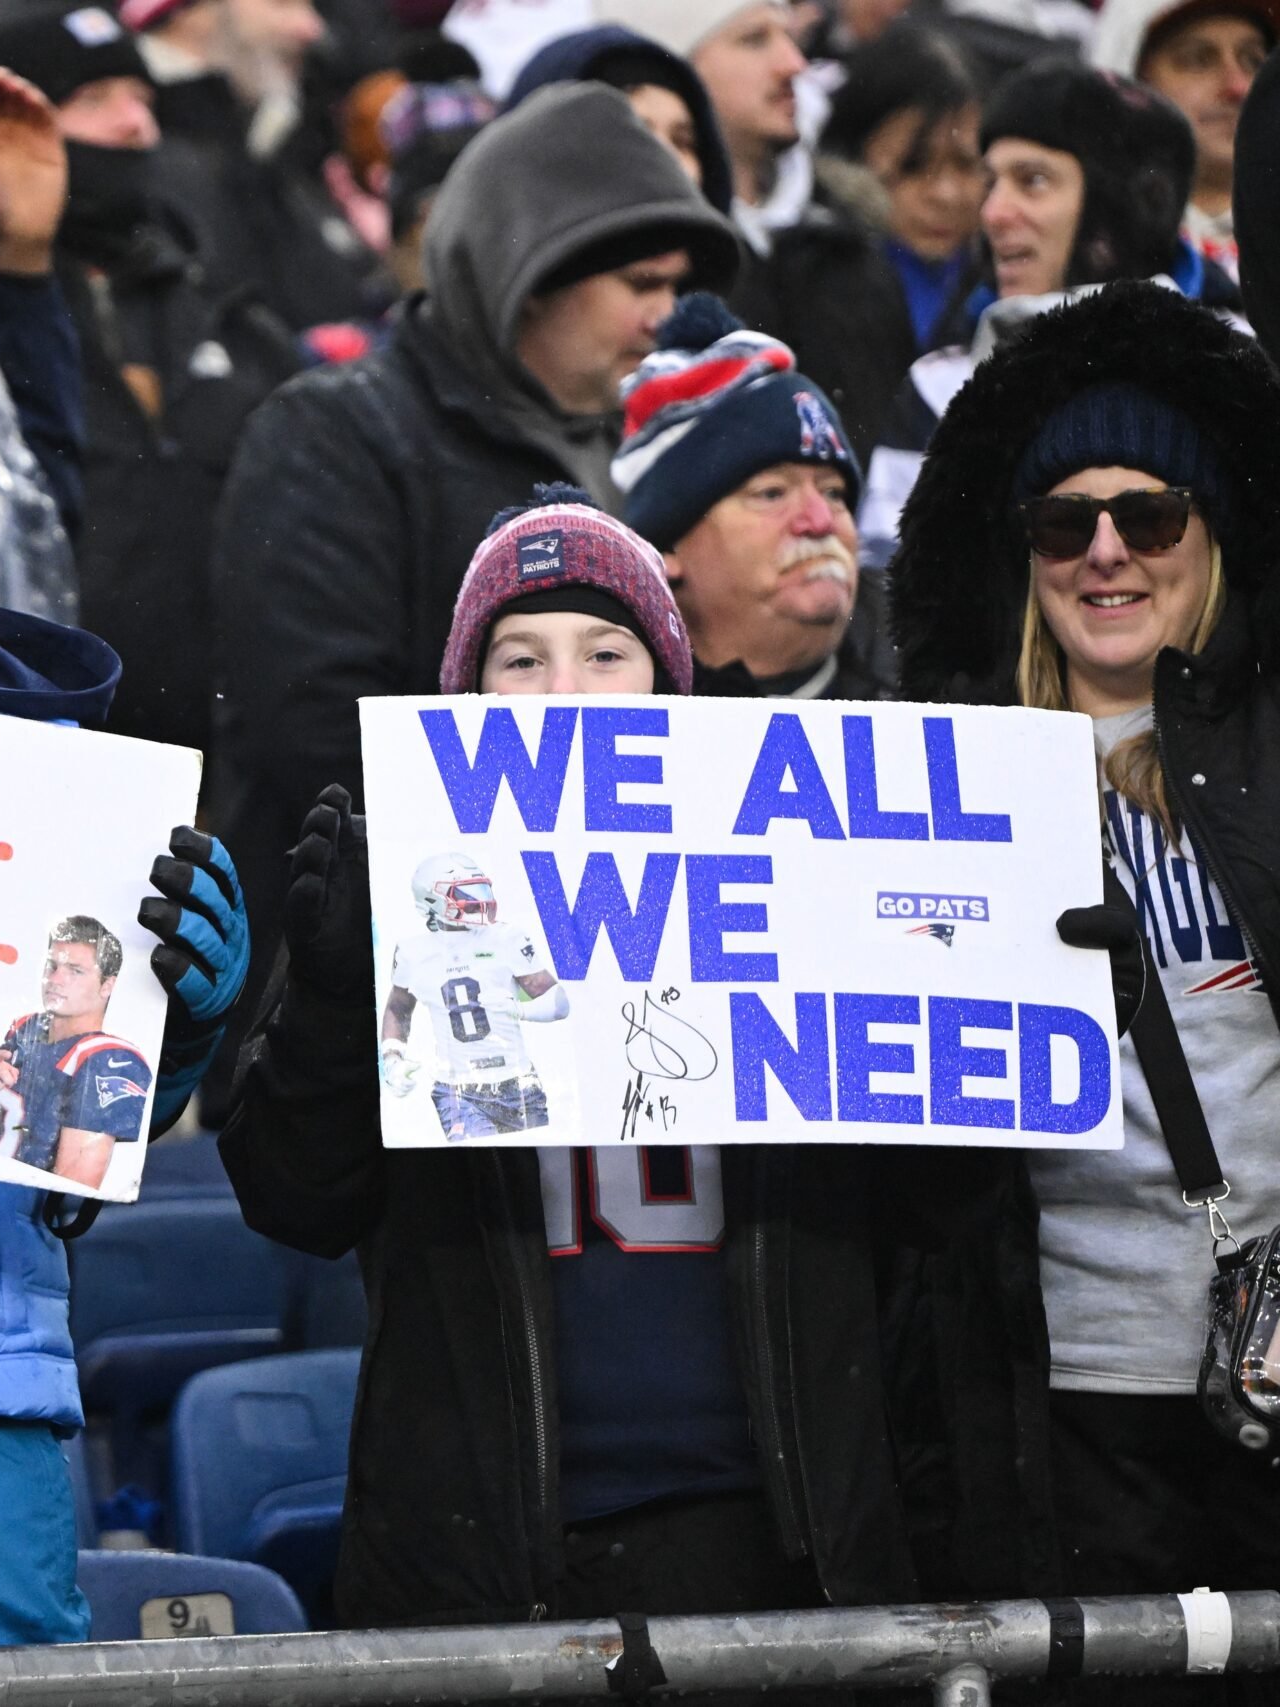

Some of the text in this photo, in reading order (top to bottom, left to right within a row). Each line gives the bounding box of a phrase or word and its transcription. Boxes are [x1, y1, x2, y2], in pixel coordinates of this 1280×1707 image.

[522, 560, 560, 574] PATRIOTS
[417, 706, 1013, 843] WE ALL
[520, 850, 781, 983] WE
[878, 897, 986, 918] GO PATS
[729, 991, 1112, 1135] NEED
[167, 1599, 190, 1629] 9
